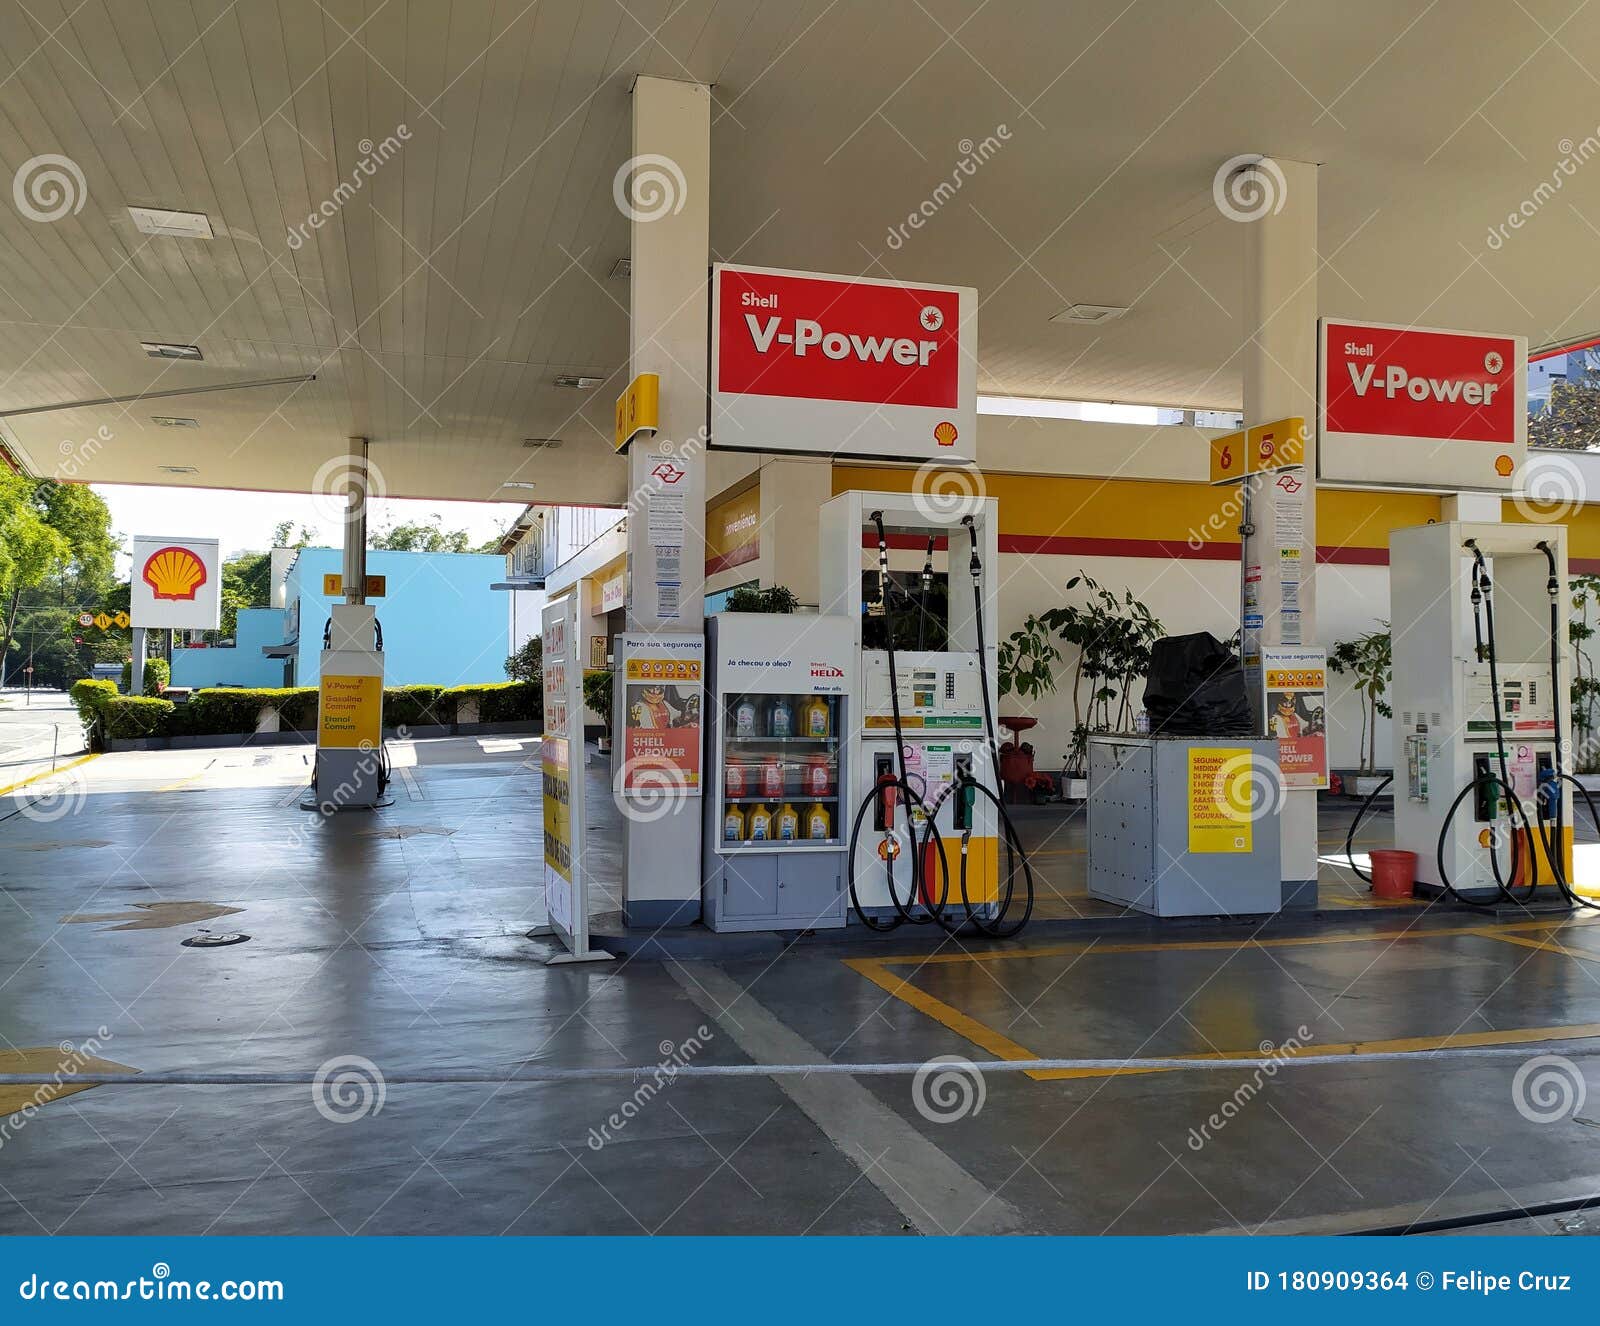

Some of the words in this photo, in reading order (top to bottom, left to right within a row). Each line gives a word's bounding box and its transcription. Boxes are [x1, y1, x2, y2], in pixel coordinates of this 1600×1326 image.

[741, 292, 778, 309] Shell
[743, 313, 939, 367] V-Power
[1344, 342, 1373, 357] Shell
[1346, 361, 1499, 406] V-Power
[630, 393, 636, 422] 3
[1260, 433, 1275, 460] 5
[1220, 446, 1232, 470] 6
[329, 579, 336, 591] 1
[371, 580, 381, 593] 2
[81, 615, 91, 623] 40
[663, 642, 702, 650] segurança
[738, 659, 764, 667] checou
[810, 668, 845, 677] HELIX
[325, 695, 362, 703] Gasolina
[324, 715, 351, 723] Etanol
[324, 722, 356, 731] Comum
[633, 737, 664, 746] SHELL
[633, 748, 685, 757] V-POWER
[1279, 754, 1313, 762] -POWER
